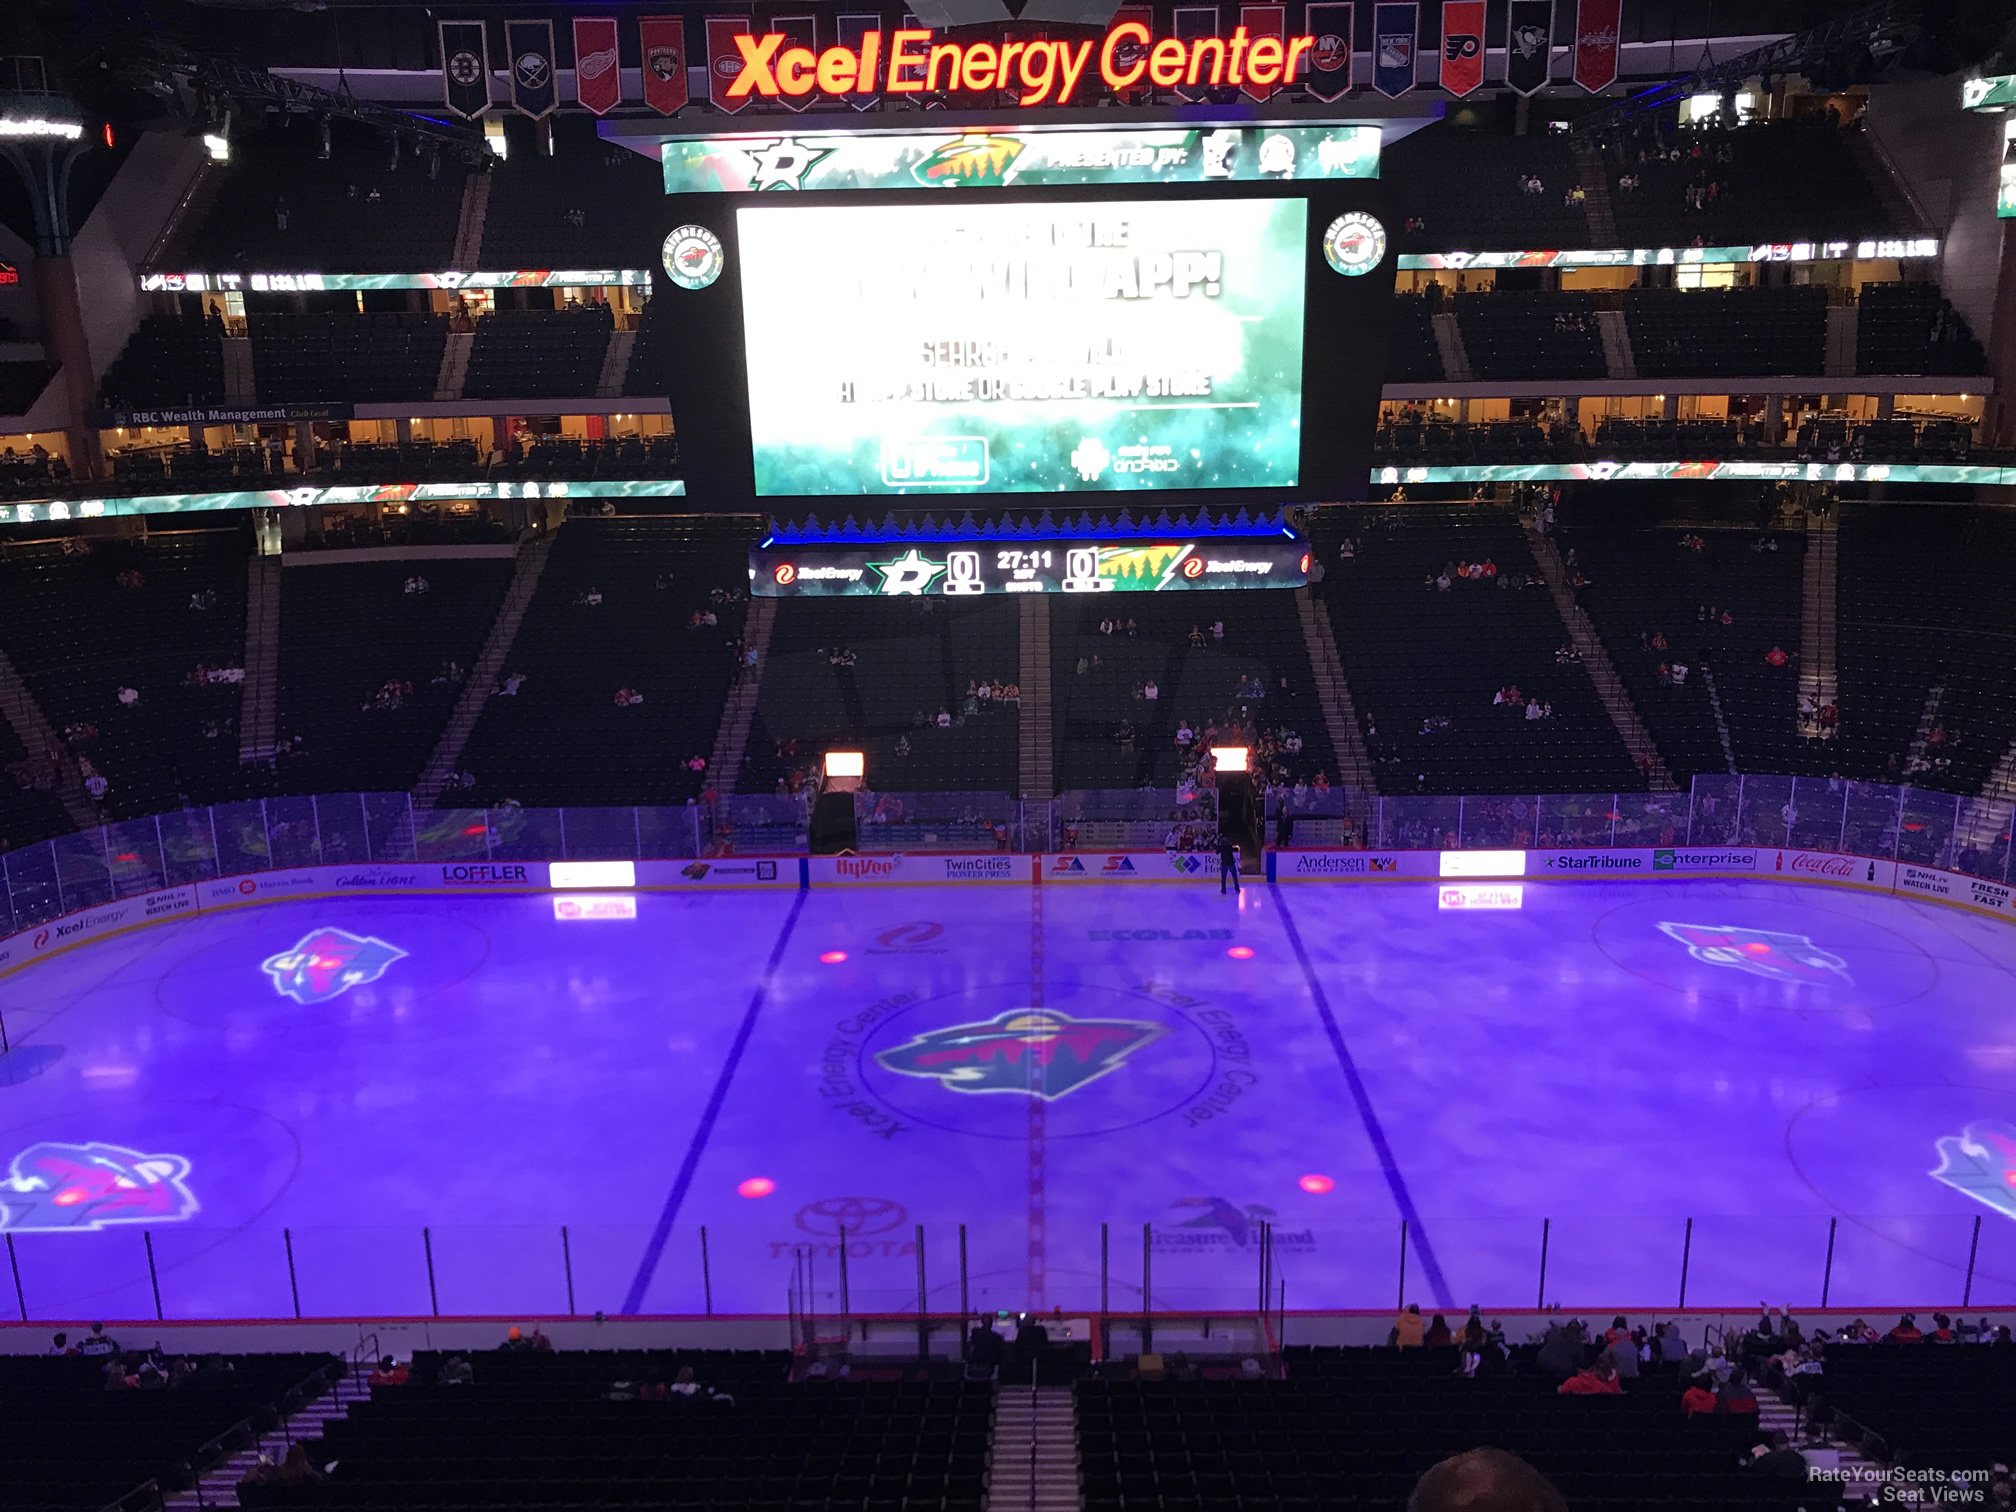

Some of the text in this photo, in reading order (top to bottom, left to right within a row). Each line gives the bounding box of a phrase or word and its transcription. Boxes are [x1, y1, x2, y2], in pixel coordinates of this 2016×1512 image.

[726, 21, 1314, 106] Xcel Energy Center
[1047, 150, 1154, 168] PRESENTED
[1325, 212, 1384, 240] MINNESOTA
[664, 227, 721, 255] MINNESOTA
[1104, 249, 1223, 300] APP!
[132, 412, 157, 424] RBC
[160, 410, 205, 423] Wealth
[208, 408, 286, 422] Management
[953, 554, 973, 580] 0
[997, 551, 1052, 569] 27:11
[1075, 552, 1093, 578] 0
[1297, 855, 1365, 868] Andersen
[1660, 852, 1754, 866] enterprise
[335, 874, 376, 888] Golden
[443, 865, 527, 880] LOFFLER
[946, 870, 1011, 878] PIONEER PRESS
[212, 887, 236, 897] BMO
[260, 877, 314, 889] Harris Bank
[1903, 878, 1950, 894] WATCH LIVE
[1971, 882, 2009, 897] FRESH
[145, 900, 190, 916] WATCH LIVE
[1974, 894, 2003, 907] FAST
[56, 910, 125, 938] Xcel Energy
[1088, 928, 1235, 942] ECOLAB
[837, 991, 919, 1034] Center
[1197, 1010, 1251, 1066] Energy
[818, 1036, 860, 1097] Energy
[1182, 1070, 1257, 1128] Center
[832, 1101, 913, 1140] Xcel
[768, 1241, 920, 1259] TOYOTA
